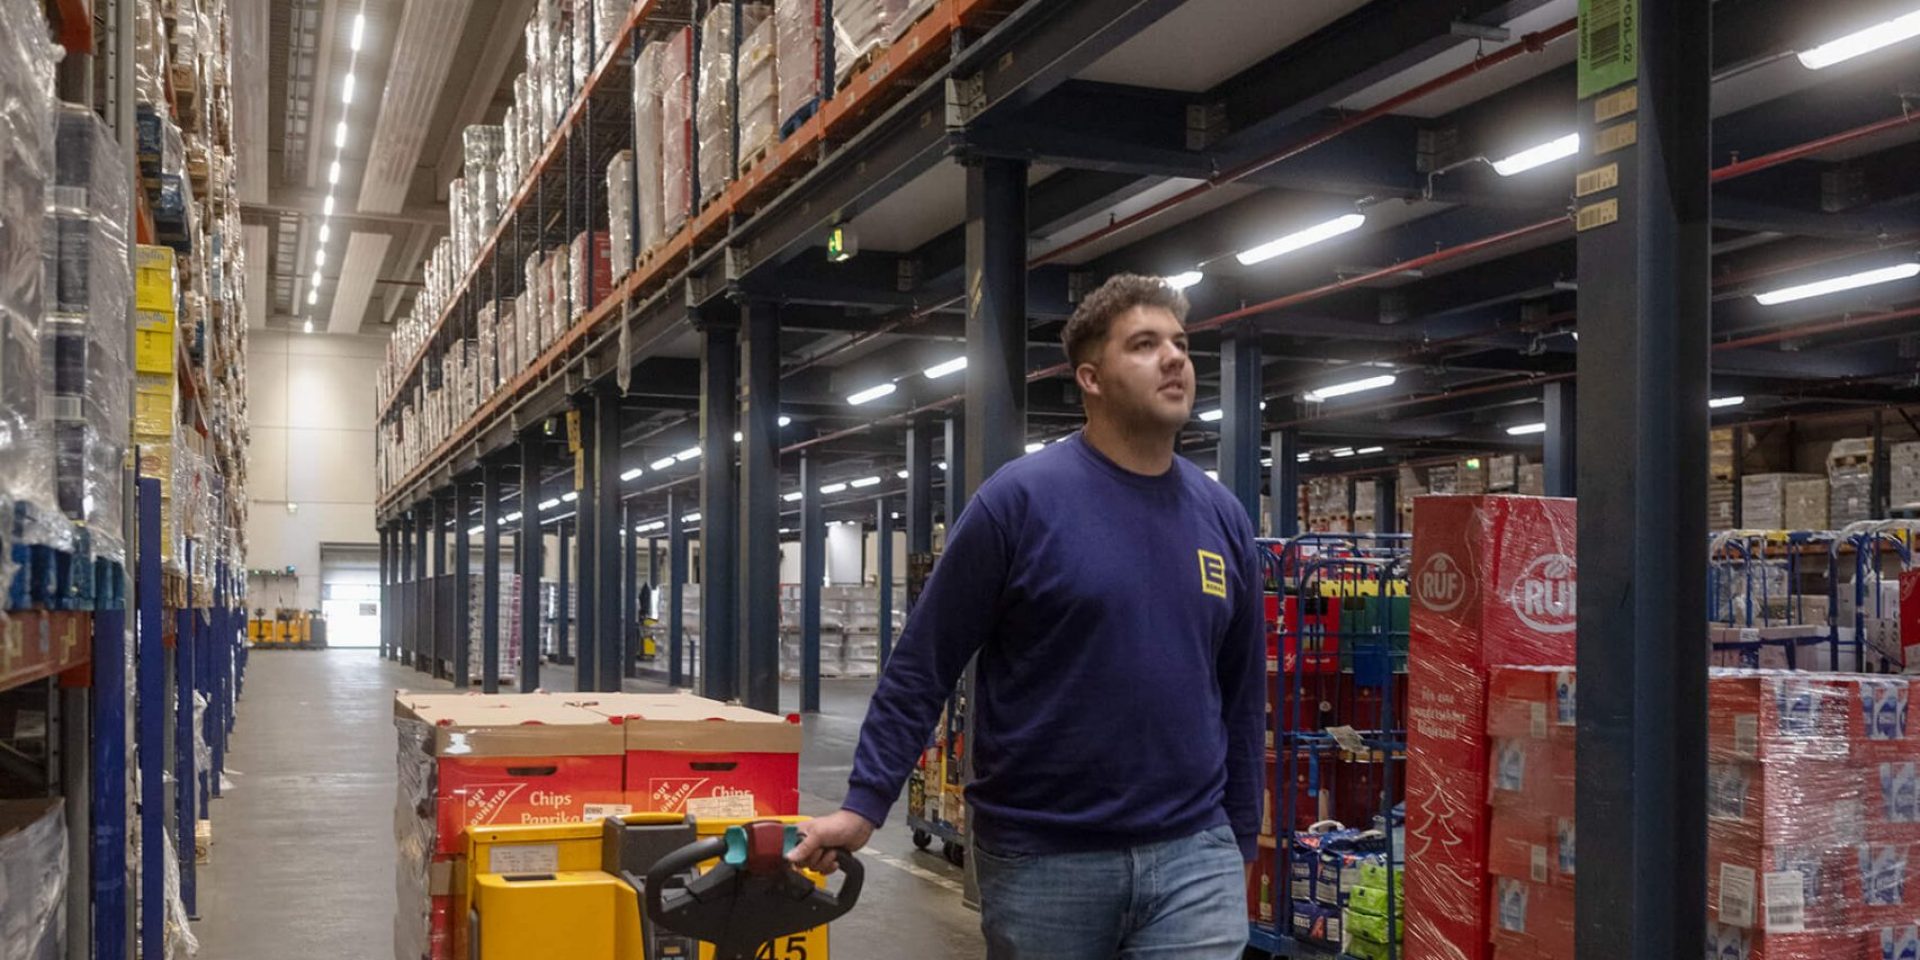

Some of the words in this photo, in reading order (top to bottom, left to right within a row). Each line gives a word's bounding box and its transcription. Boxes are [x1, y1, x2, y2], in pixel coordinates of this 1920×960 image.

[1423, 572, 1458, 599] RUF
[467, 788, 485, 807] GUT
[529, 790, 572, 809] Chips
[653, 782, 670, 800] GUT
[521, 811, 581, 824] Paprika
[754, 935, 807, 960] 45
